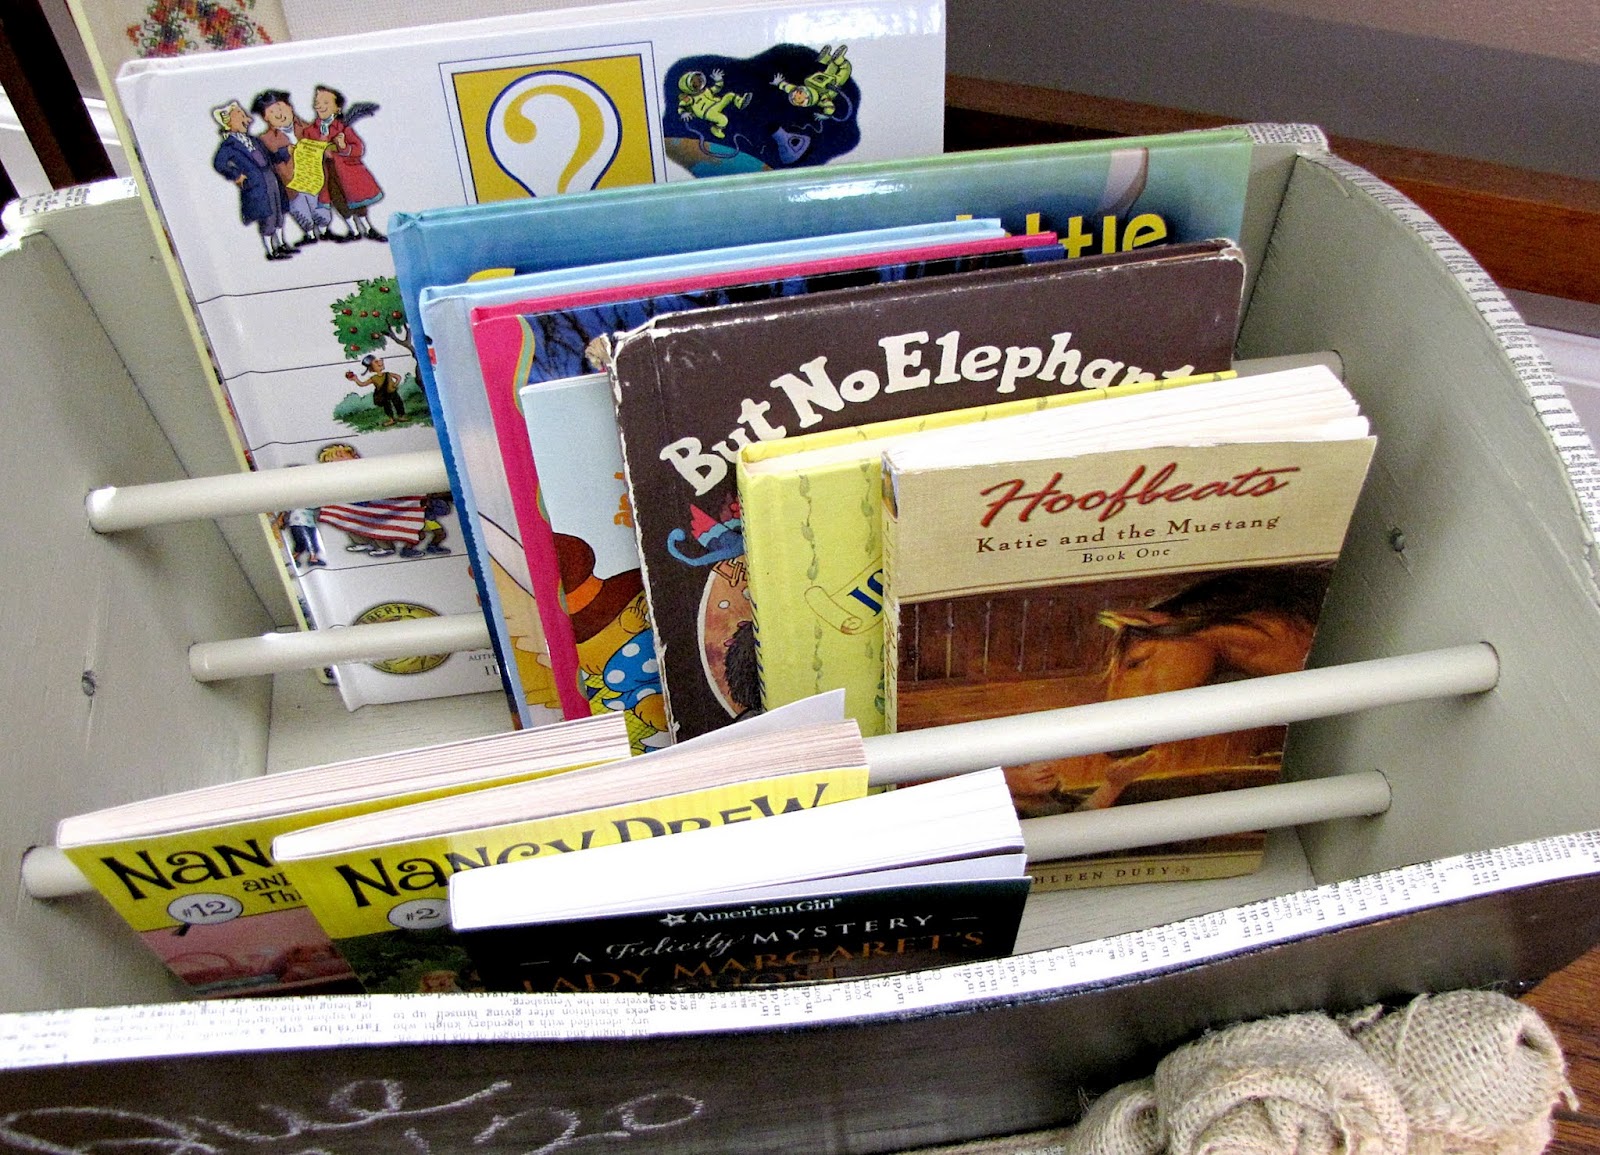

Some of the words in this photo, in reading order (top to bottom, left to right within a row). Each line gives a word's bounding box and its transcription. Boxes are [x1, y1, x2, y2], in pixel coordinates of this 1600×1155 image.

[660, 398, 786, 496] But
[770, 356, 881, 429] No
[980, 462, 1300, 529] Hoofbeats
[976, 534, 1048, 555] Katie
[1060, 526, 1106, 547] and
[1117, 522, 1156, 541] the
[1166, 517, 1281, 539] Mustang
[1081, 550, 1127, 564] Book
[1136, 546, 1172, 560] One
[1033, 871, 1104, 885] HLEEN
[1115, 866, 1170, 879] DUEY
[182, 899, 234, 919] #12
[405, 906, 441, 922] #2
[571, 951, 593, 964] A
[605, 932, 744, 961] Felicity
[752, 914, 934, 945] MYSTERY
